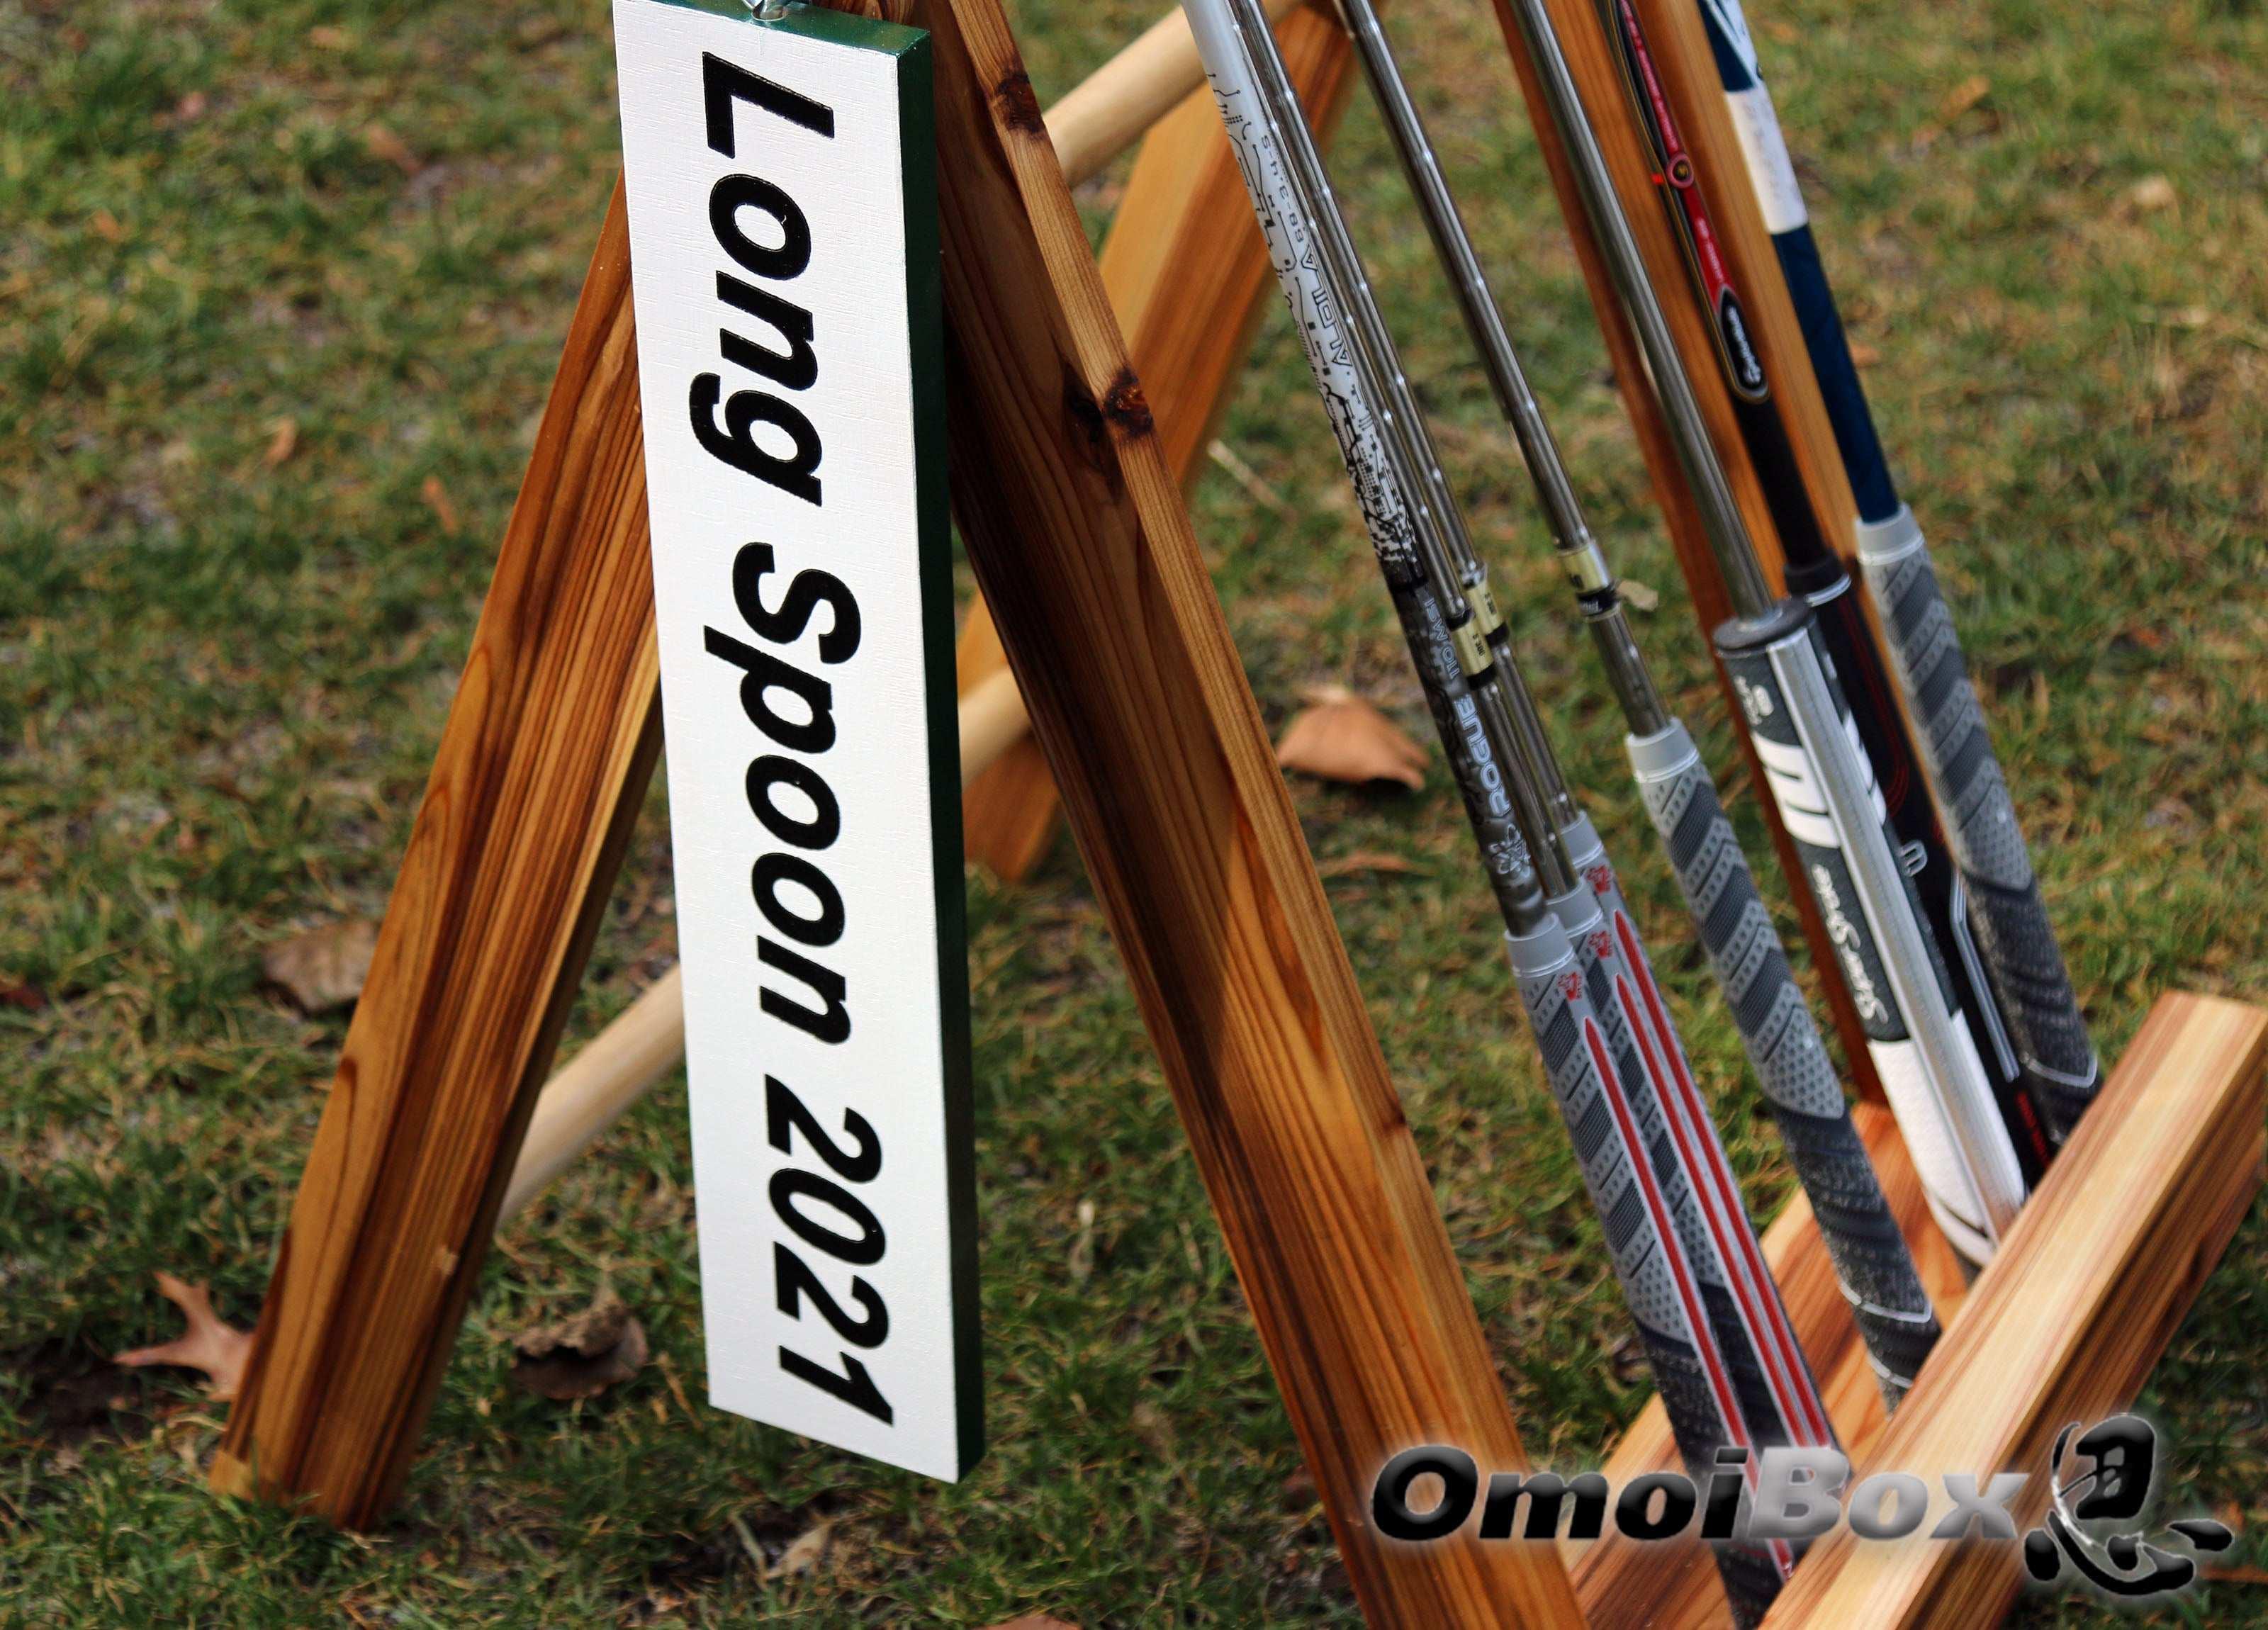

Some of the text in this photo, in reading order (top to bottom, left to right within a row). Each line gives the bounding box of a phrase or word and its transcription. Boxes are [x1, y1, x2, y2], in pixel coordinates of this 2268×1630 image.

[1301, 245, 1353, 367] ALDILA
[1424, 597, 1448, 641] MSI
[689, 51, 894, 1425] Long Spoon 2021
[1453, 693, 1514, 818] ROGUE
